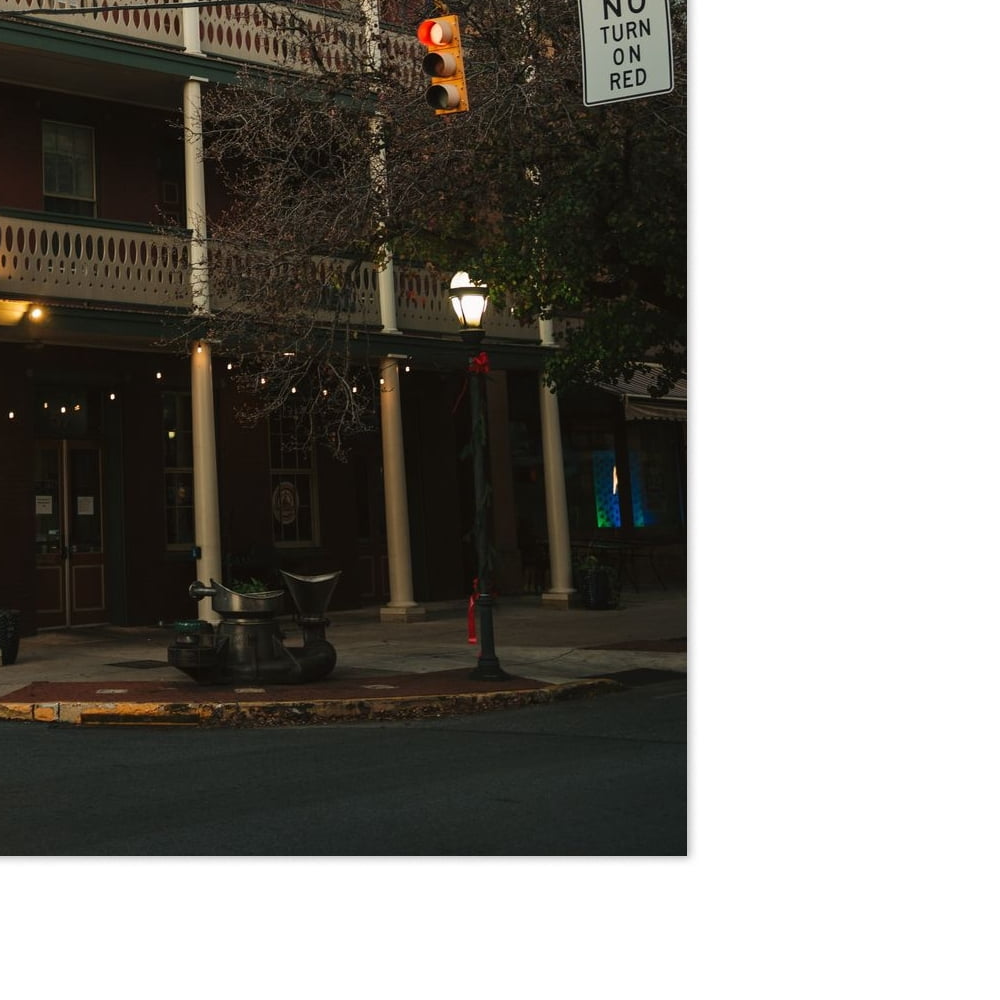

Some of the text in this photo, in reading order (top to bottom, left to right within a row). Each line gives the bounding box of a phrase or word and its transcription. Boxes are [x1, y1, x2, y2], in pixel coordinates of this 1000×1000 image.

[600, 18, 651, 44] TURN
[613, 44, 641, 66] ON
[610, 68, 647, 91] RED
